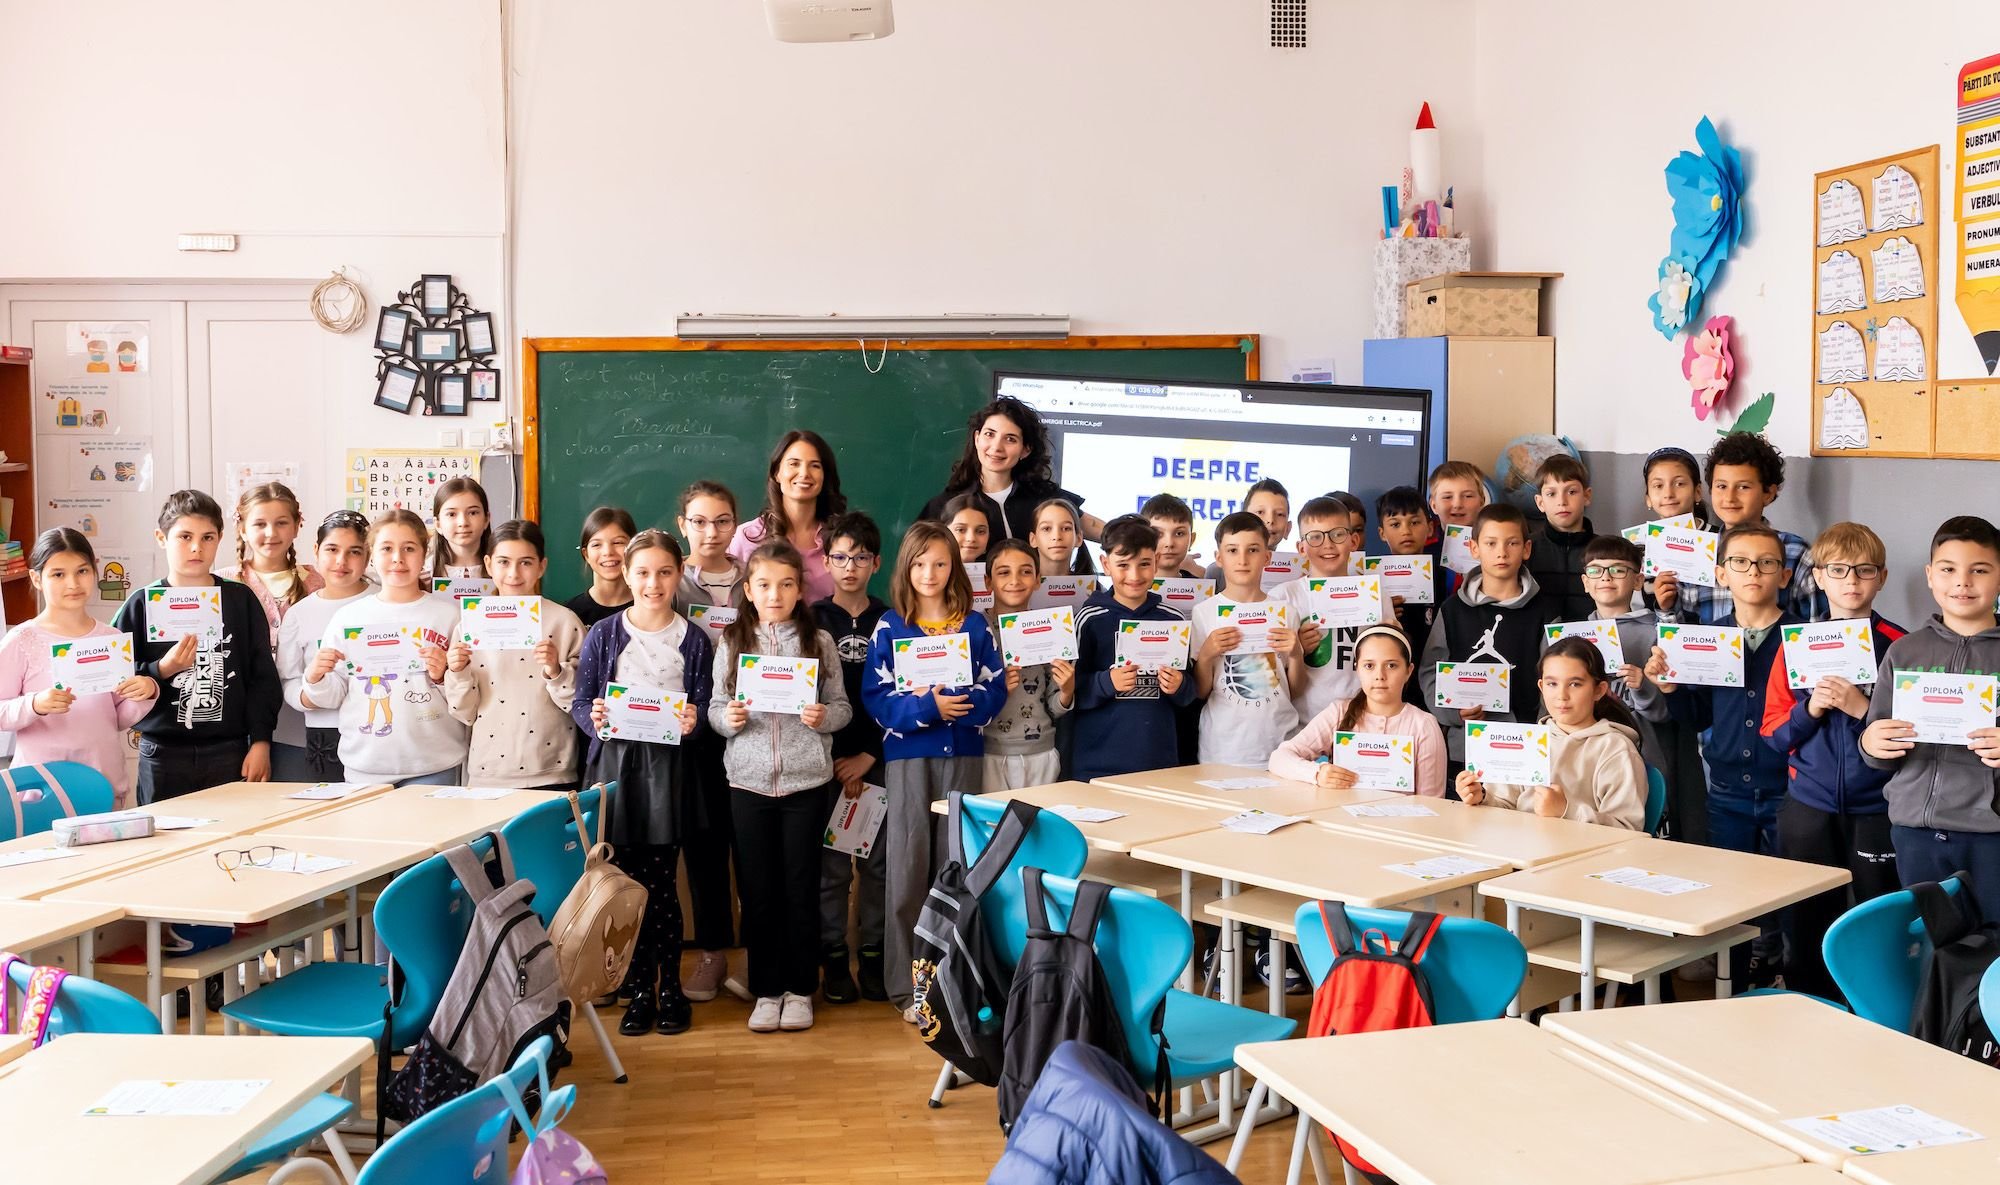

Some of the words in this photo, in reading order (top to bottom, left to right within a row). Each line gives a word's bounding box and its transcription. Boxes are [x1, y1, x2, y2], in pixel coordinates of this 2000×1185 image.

[1983, 74, 1991, 86] DE
[1967, 257, 2000, 272] NUMERA
[370, 459, 378, 468] A
[1152, 457, 1260, 482] DESPRE
[370, 473, 378, 482] B
[382, 473, 389, 482] b
[405, 473, 413, 482] C
[439, 473, 447, 482] D
[370, 488, 378, 496] E
[405, 488, 412, 496] F
[370, 502, 378, 511] H
[382, 502, 389, 511] h
[1666, 535, 1695, 546] DIPLOMĂ
[1682, 636, 1717, 644] DIPLOMĂ
[1808, 632, 1843, 643] DIPLOMĂ
[916, 644, 947, 653] DIPLOMĂ
[1923, 686, 1964, 696] DIPLOMĂ
